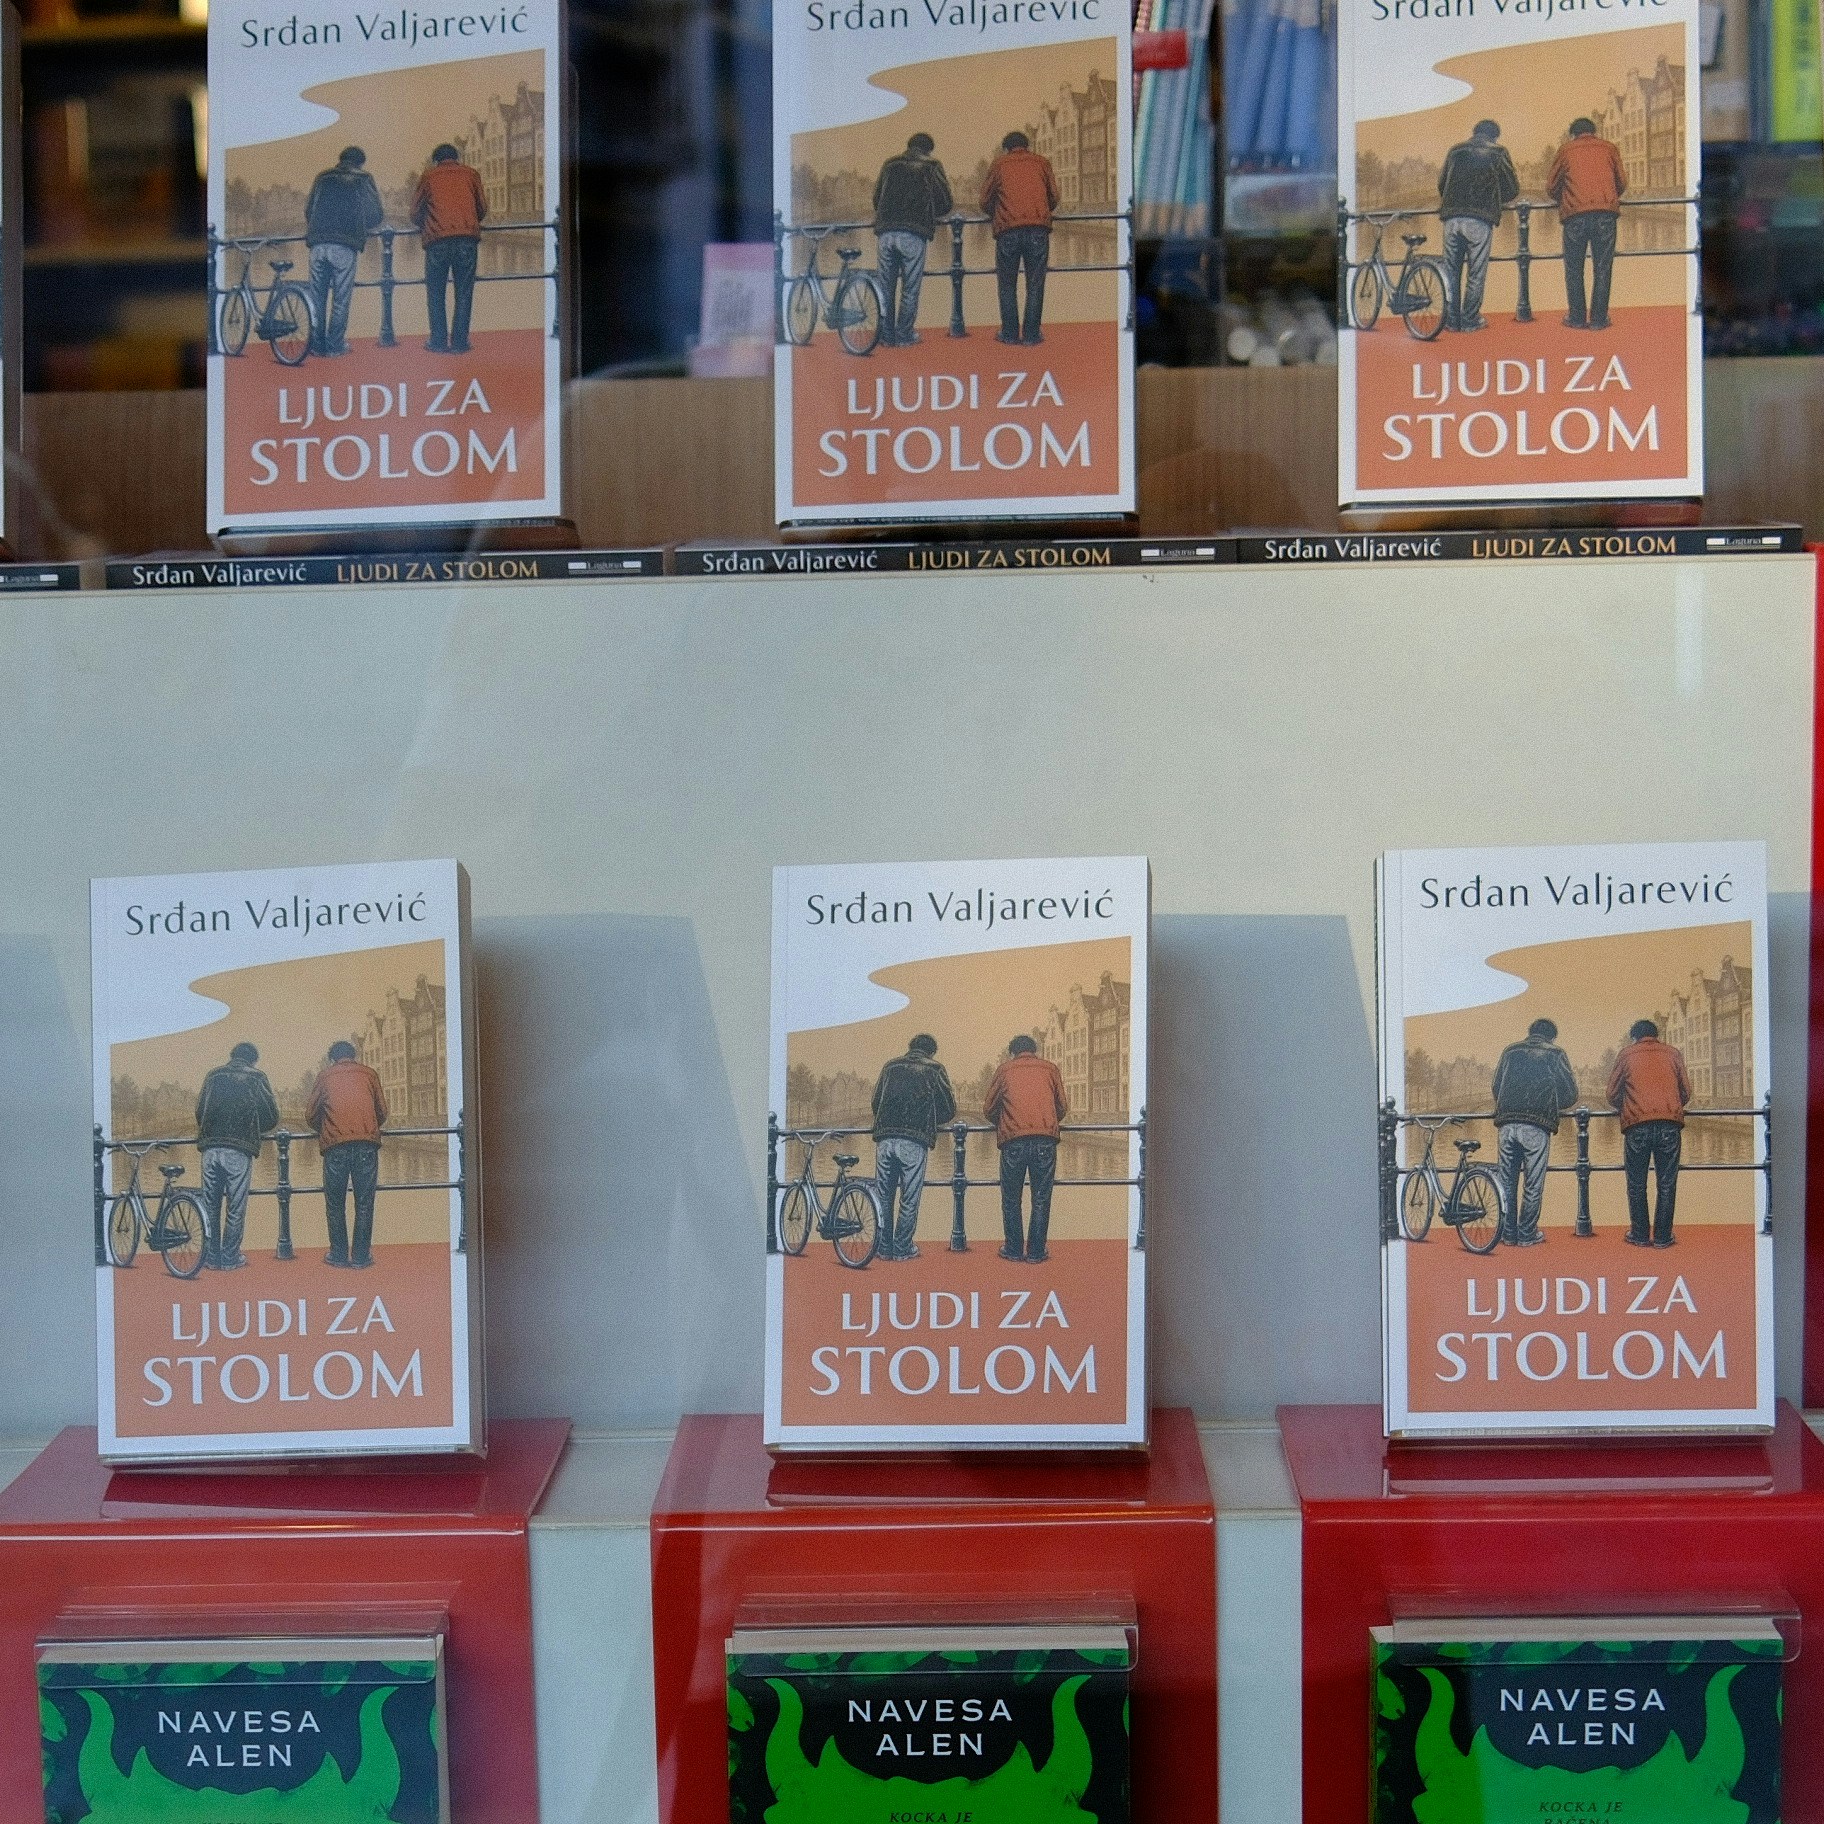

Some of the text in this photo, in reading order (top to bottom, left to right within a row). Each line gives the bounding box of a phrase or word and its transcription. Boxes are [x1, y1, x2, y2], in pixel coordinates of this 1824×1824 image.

[1467, 1276, 1697, 1324] LJUDI ZA
[1436, 1330, 1726, 1382] STOLOM
